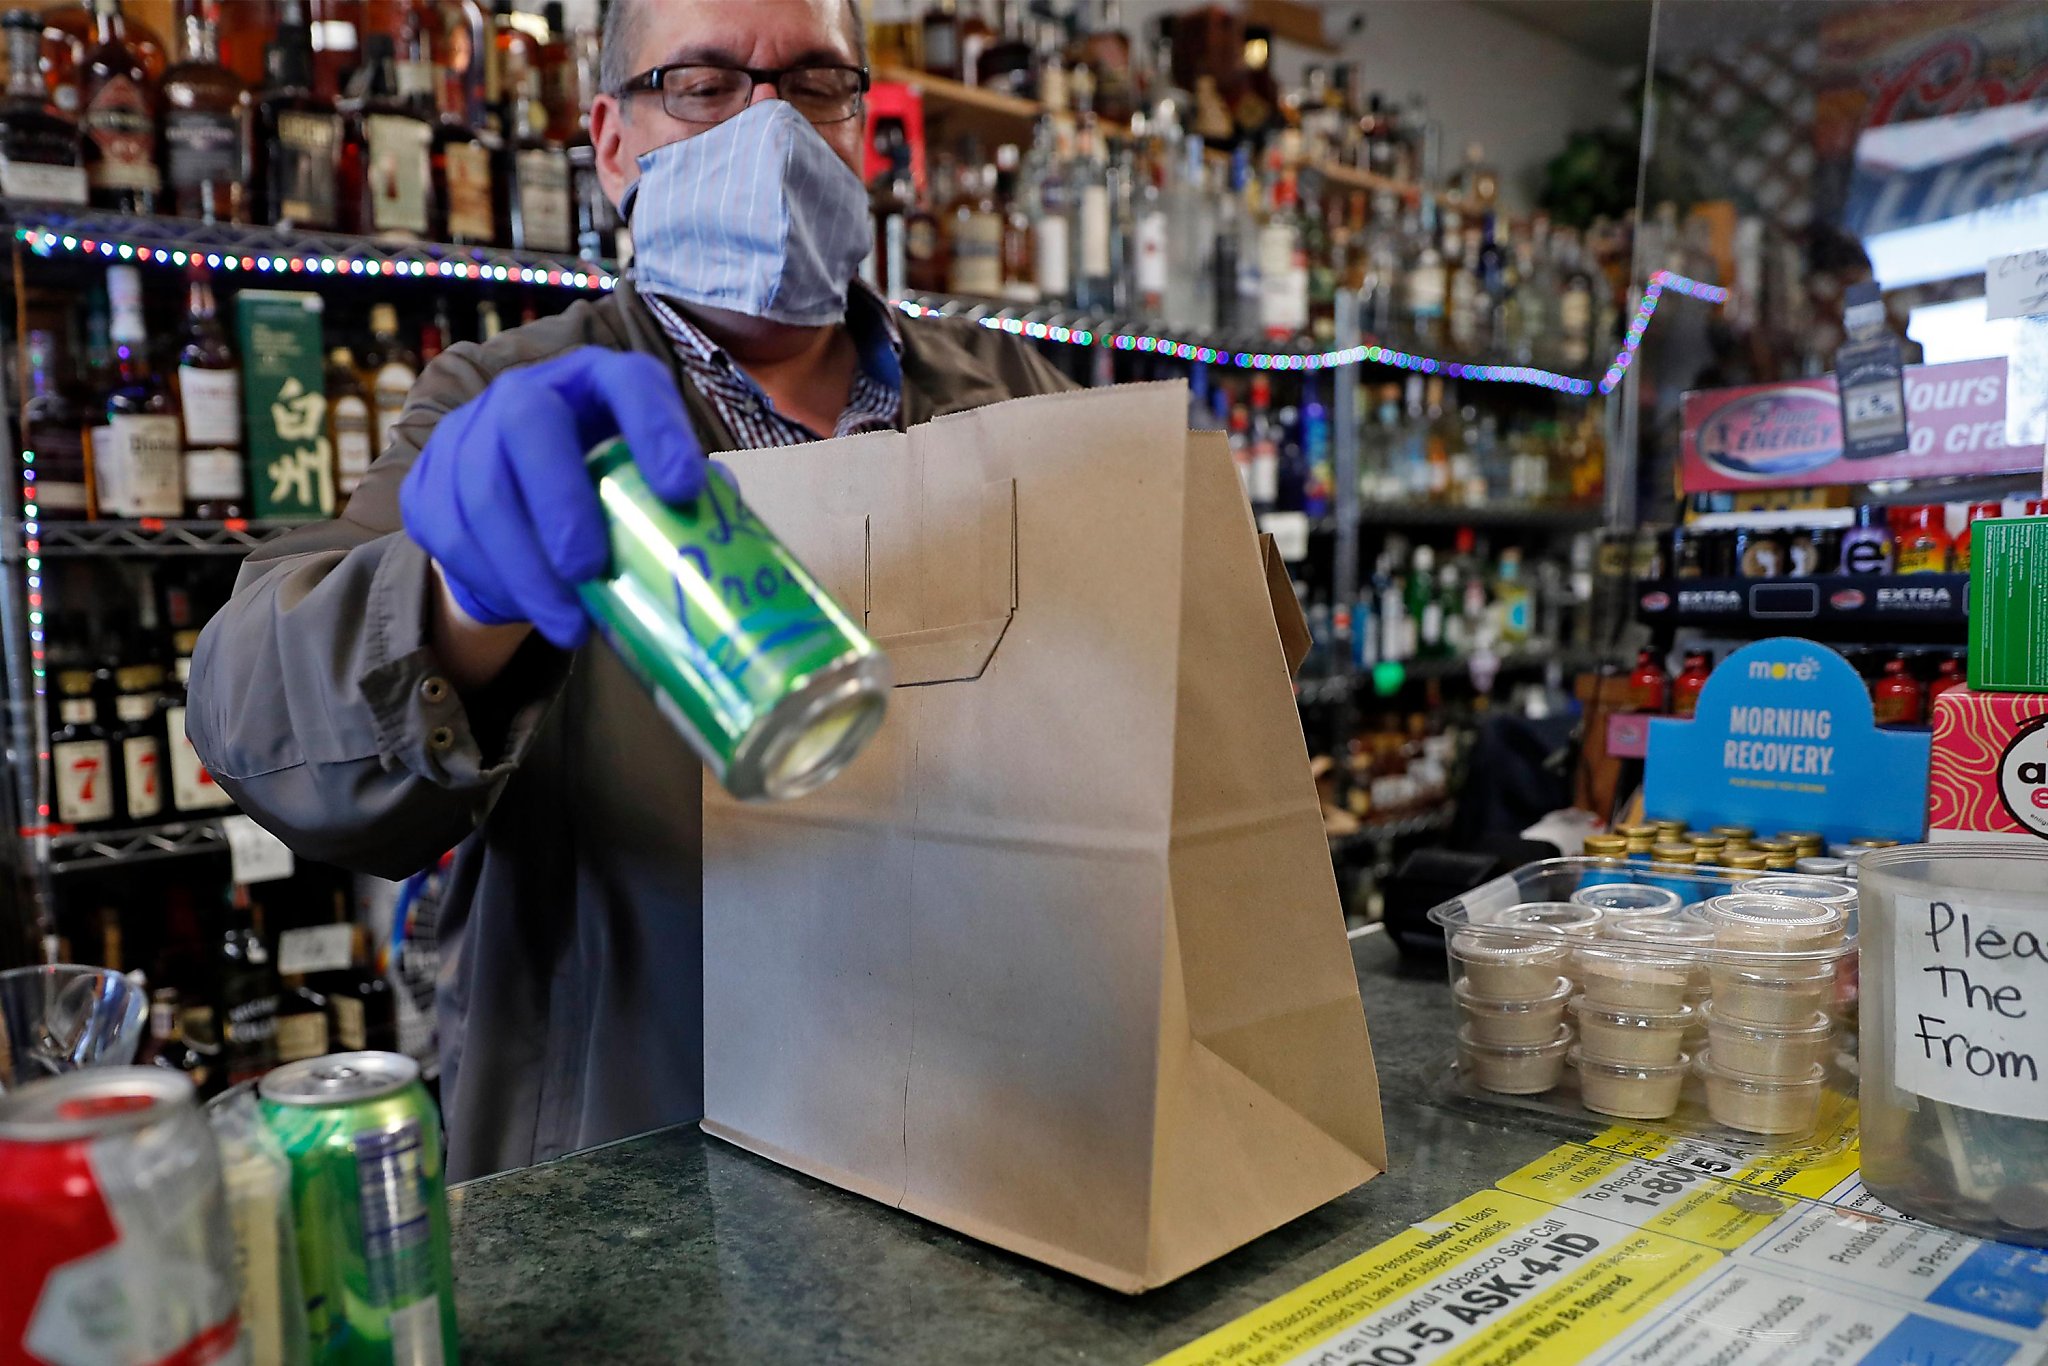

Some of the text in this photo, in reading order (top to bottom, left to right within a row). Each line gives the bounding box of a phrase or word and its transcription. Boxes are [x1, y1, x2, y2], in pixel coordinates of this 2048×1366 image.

[1904, 374, 2001, 412] ours
[268, 376, 335, 516] 白州
[1944, 419, 2007, 454] cra
[1678, 589, 1741, 603] EXTRA
[1877, 587, 1950, 602] EXTRA
[1729, 705, 1832, 740] MORNING
[138, 752, 158, 796] 7
[1723, 739, 1834, 775] RECOVERY
[73, 757, 101, 802] 7
[1925, 902, 2048, 963] Plea
[1923, 965, 2027, 1018] The
[1914, 1013, 2038, 1081] From
[1582, 1192, 1610, 1202] To
[1600, 1163, 1652, 1193] Report
[1361, 1285, 1395, 1302] Law
[1390, 1272, 1418, 1288] and
[1409, 1250, 1458, 1276] Subject
[1459, 1219, 1512, 1247] Penalties
[1374, 1247, 1425, 1273] Persons
[1415, 1230, 1455, 1250] Under
[1462, 1207, 1499, 1224] Years
[1359, 1292, 1443, 1338] Unlawful
[1432, 1256, 1507, 1294] Tobacco
[1497, 1234, 1540, 1257] Sale
[1532, 1218, 1568, 1238] Call
